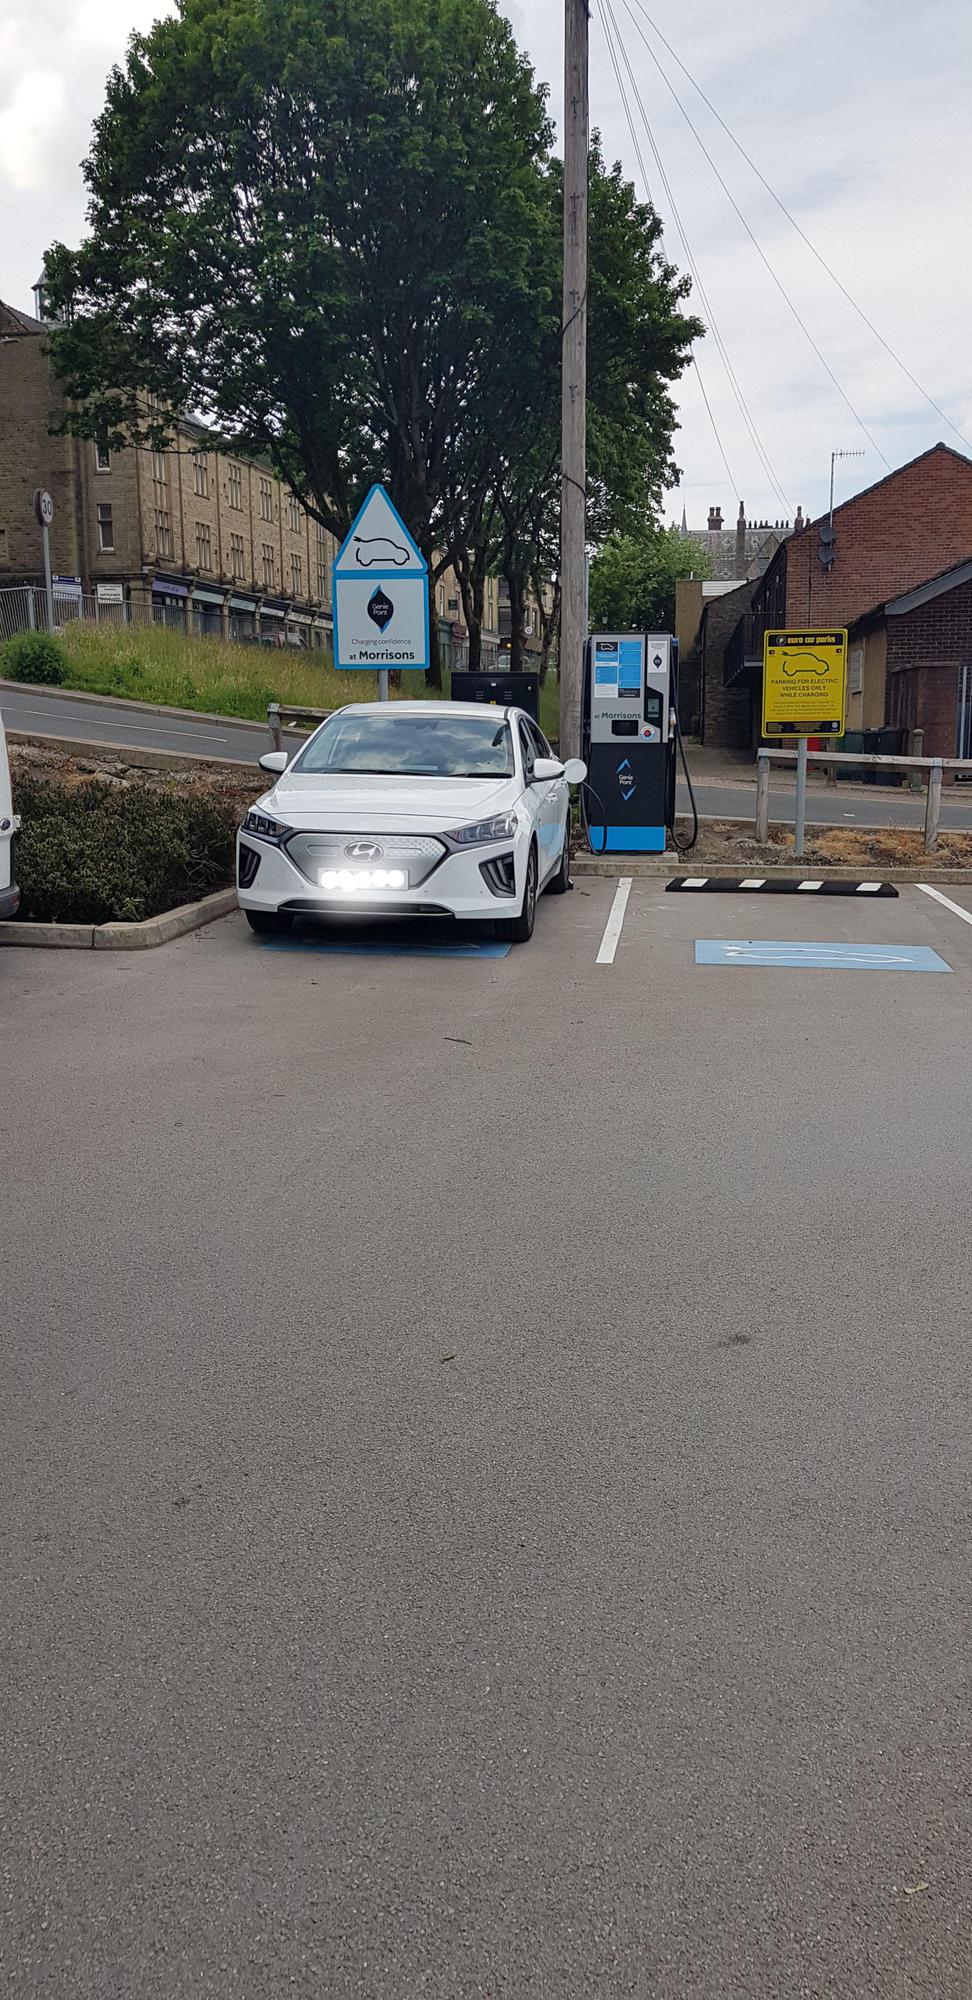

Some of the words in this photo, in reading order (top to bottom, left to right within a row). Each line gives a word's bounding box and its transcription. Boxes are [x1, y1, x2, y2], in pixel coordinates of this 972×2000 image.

[42, 499, 52, 515] 30
[815, 635, 836, 644] parks
[359, 648, 415, 660] Morrisons
[601, 711, 642, 719] Morrisons
